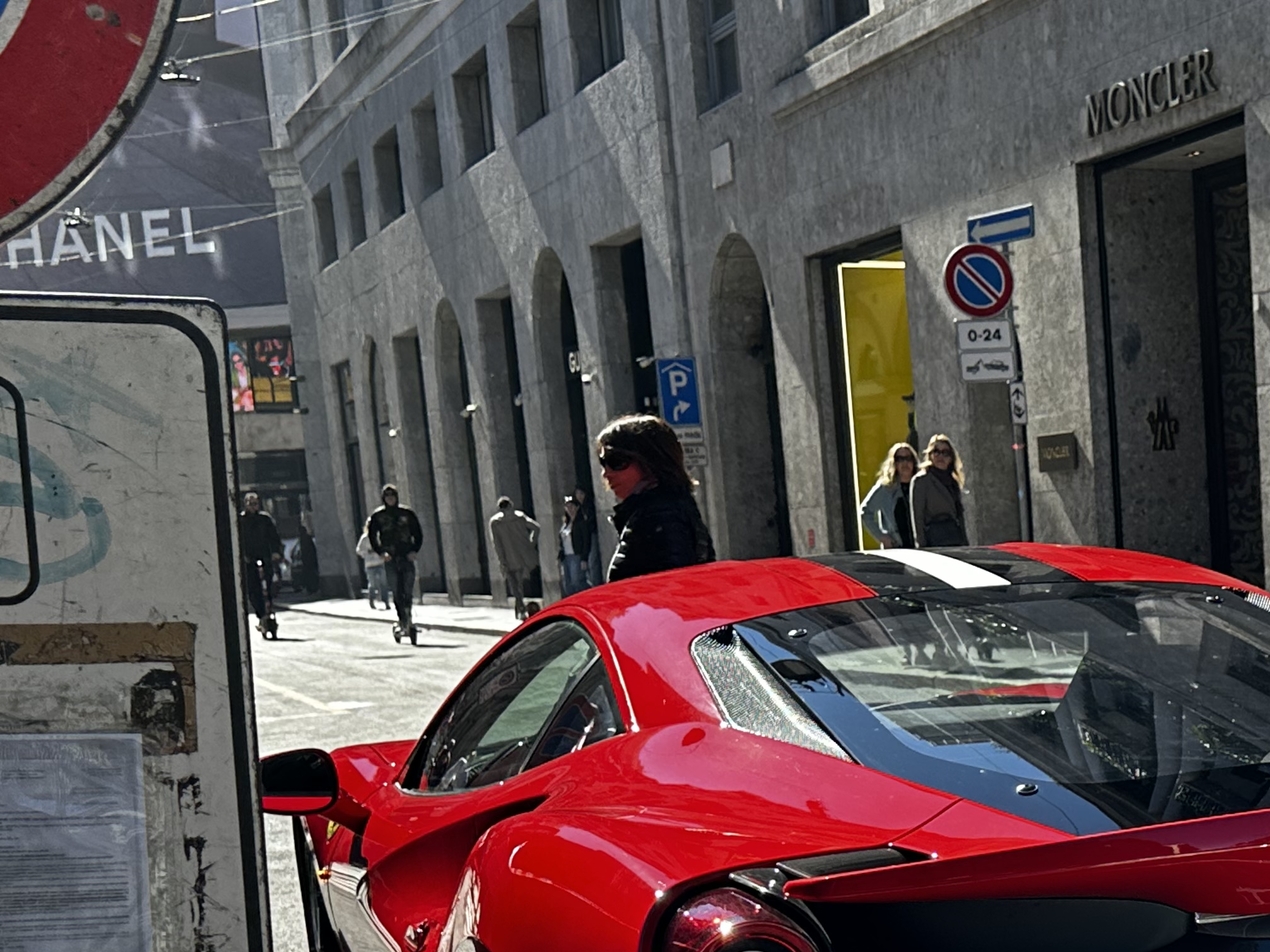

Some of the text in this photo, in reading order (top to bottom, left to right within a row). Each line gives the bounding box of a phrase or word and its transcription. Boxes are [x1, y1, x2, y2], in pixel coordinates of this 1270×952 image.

[1085, 48, 1219, 138] MONCLER
[967, 328, 1002, 342] 0-24
[669, 370, 688, 396] P
